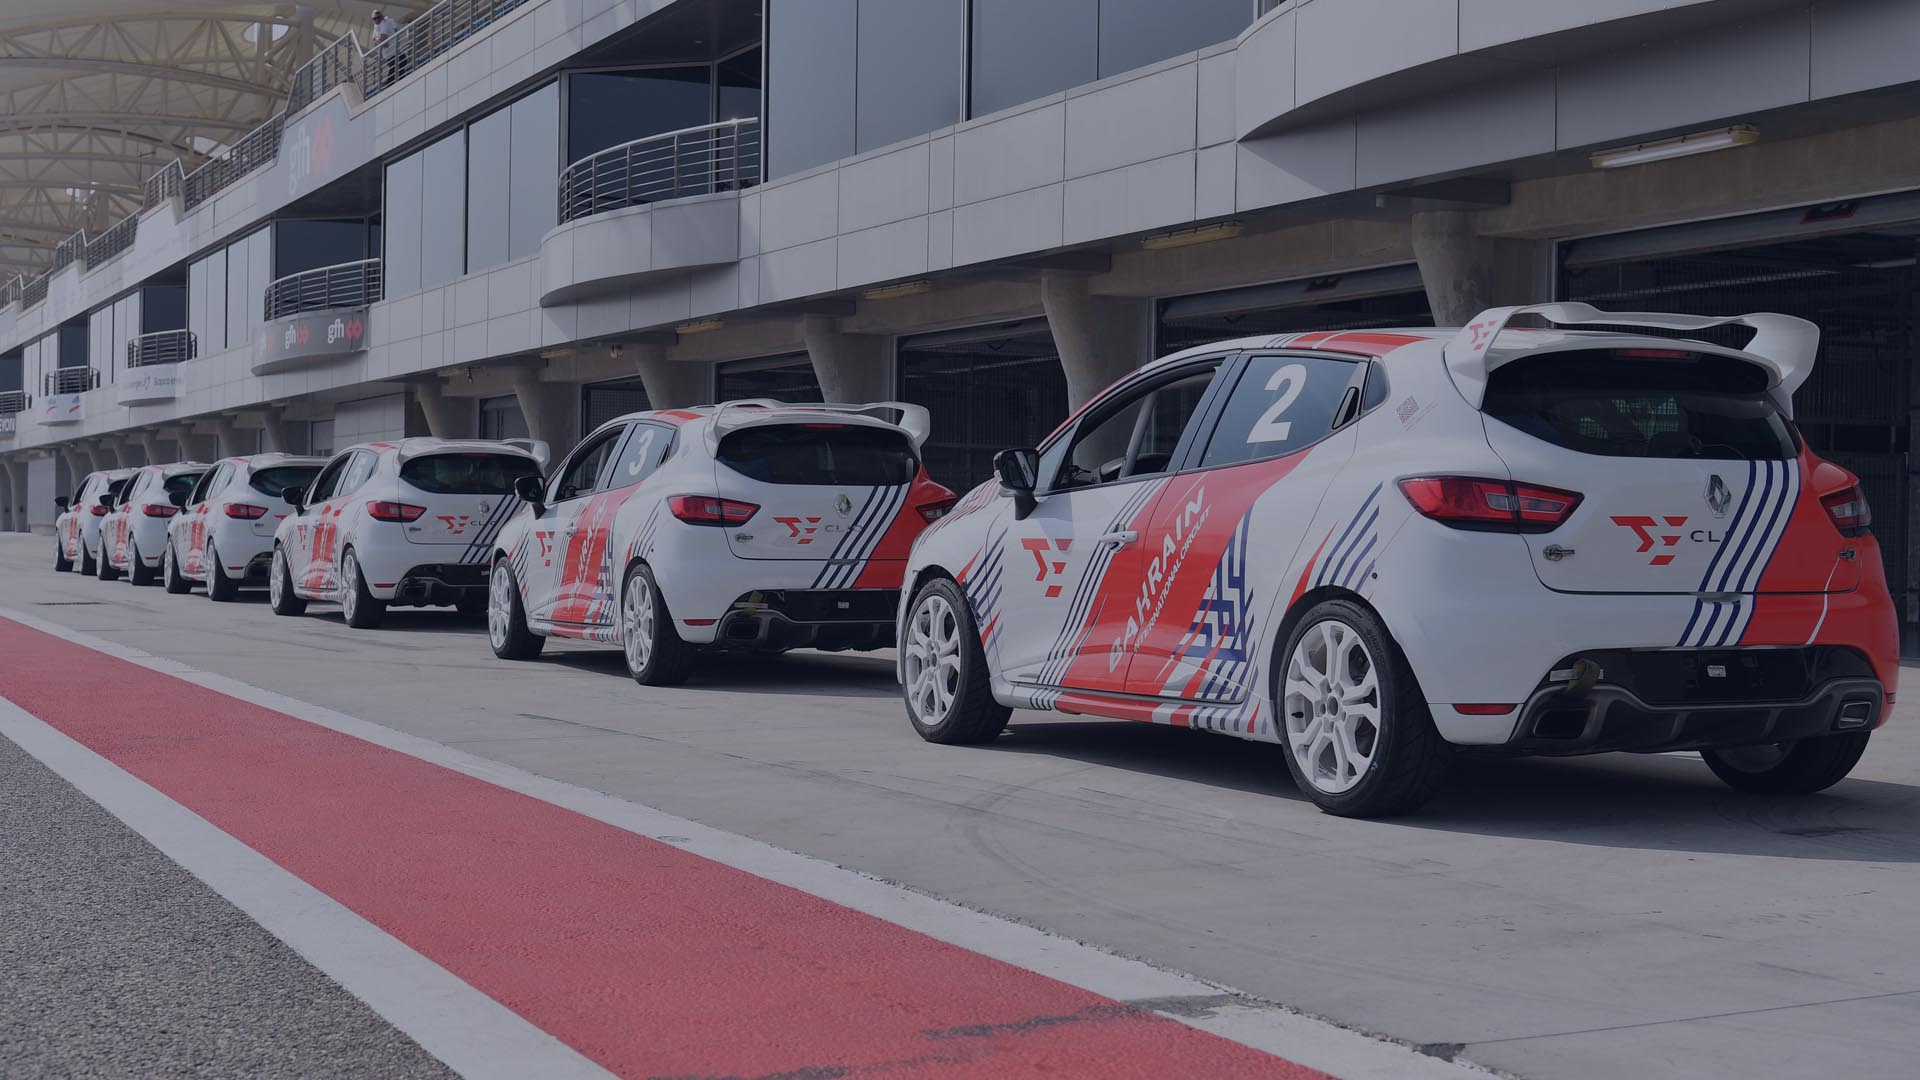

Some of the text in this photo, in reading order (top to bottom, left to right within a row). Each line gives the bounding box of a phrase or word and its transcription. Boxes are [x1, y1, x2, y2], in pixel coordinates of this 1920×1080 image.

[285, 324, 297, 350] gfh
[327, 318, 345, 344] gfh
[1246, 363, 1308, 444] 2
[628, 430, 656, 477] 3
[1110, 486, 1205, 674] BAHRAIN
[1133, 504, 1212, 658] INTERNATIONAL CIRCUIT
